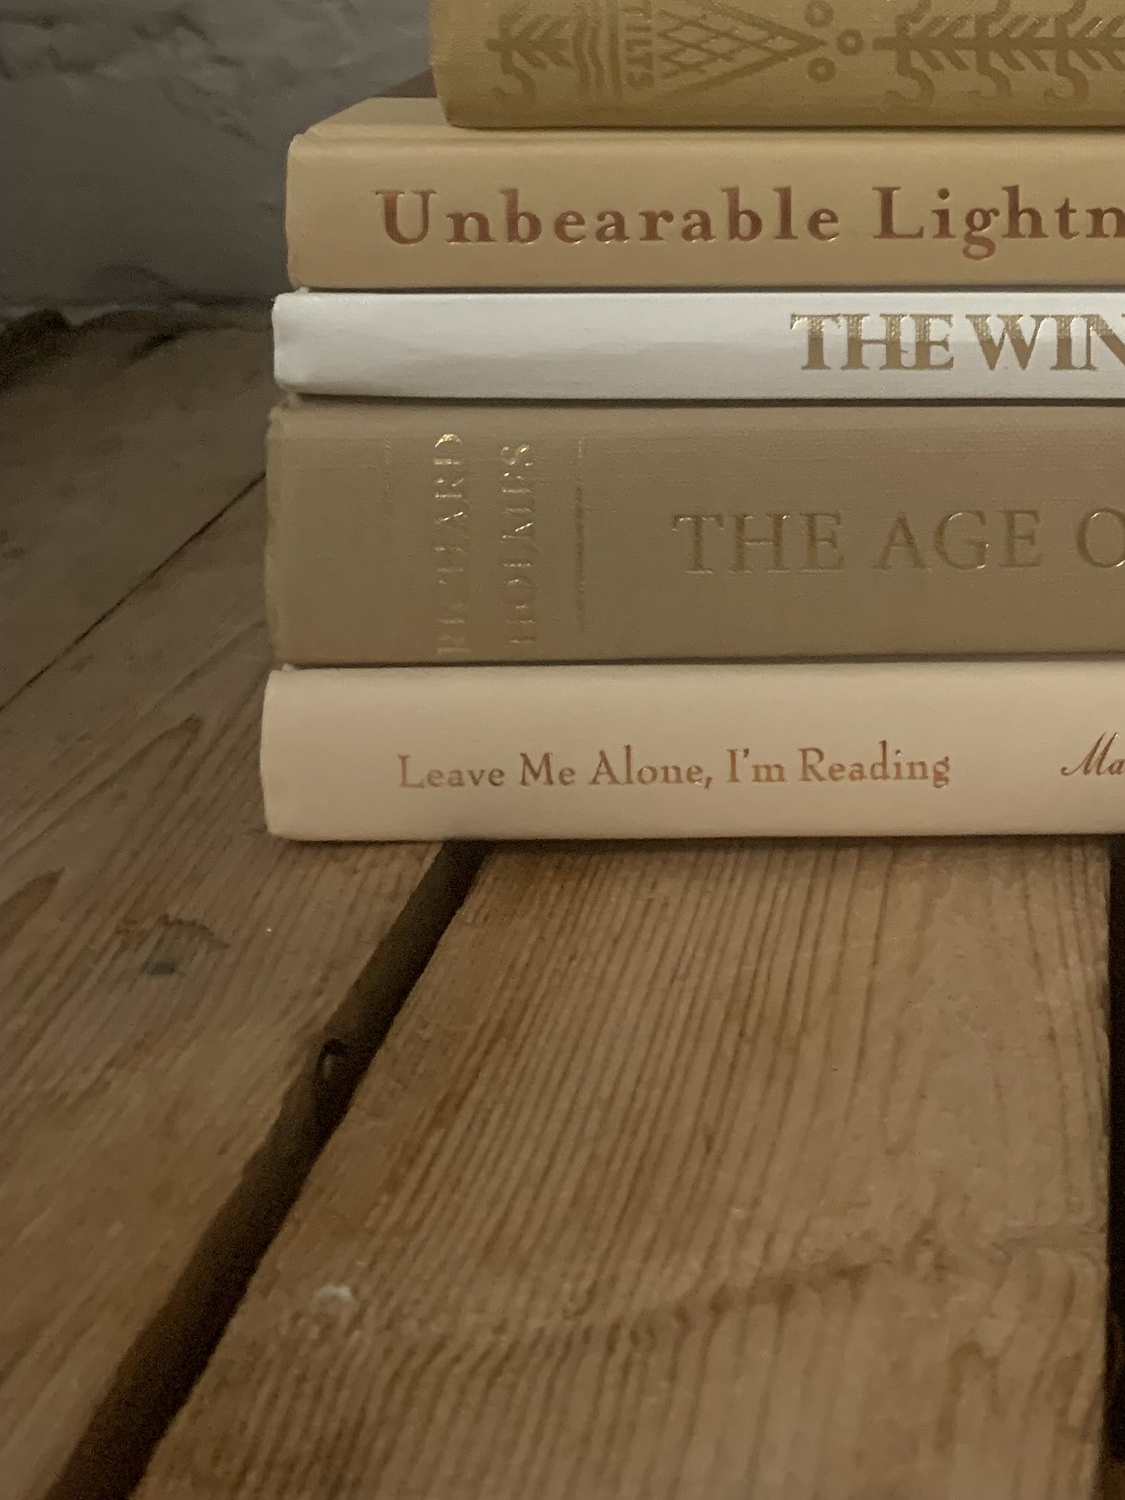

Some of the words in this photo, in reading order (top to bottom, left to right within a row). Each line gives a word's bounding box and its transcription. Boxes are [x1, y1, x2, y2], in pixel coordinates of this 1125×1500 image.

[375, 186, 840, 244] Unbearable
[790, 313, 955, 371] THE
[671, 510, 844, 573] THE
[872, 508, 1043, 571] AGE
[398, 754, 505, 789] Leave
[520, 752, 575, 787] Me
[588, 745, 713, 789] Alone,
[726, 748, 785, 784] I'm
[798, 740, 950, 788] Reading
